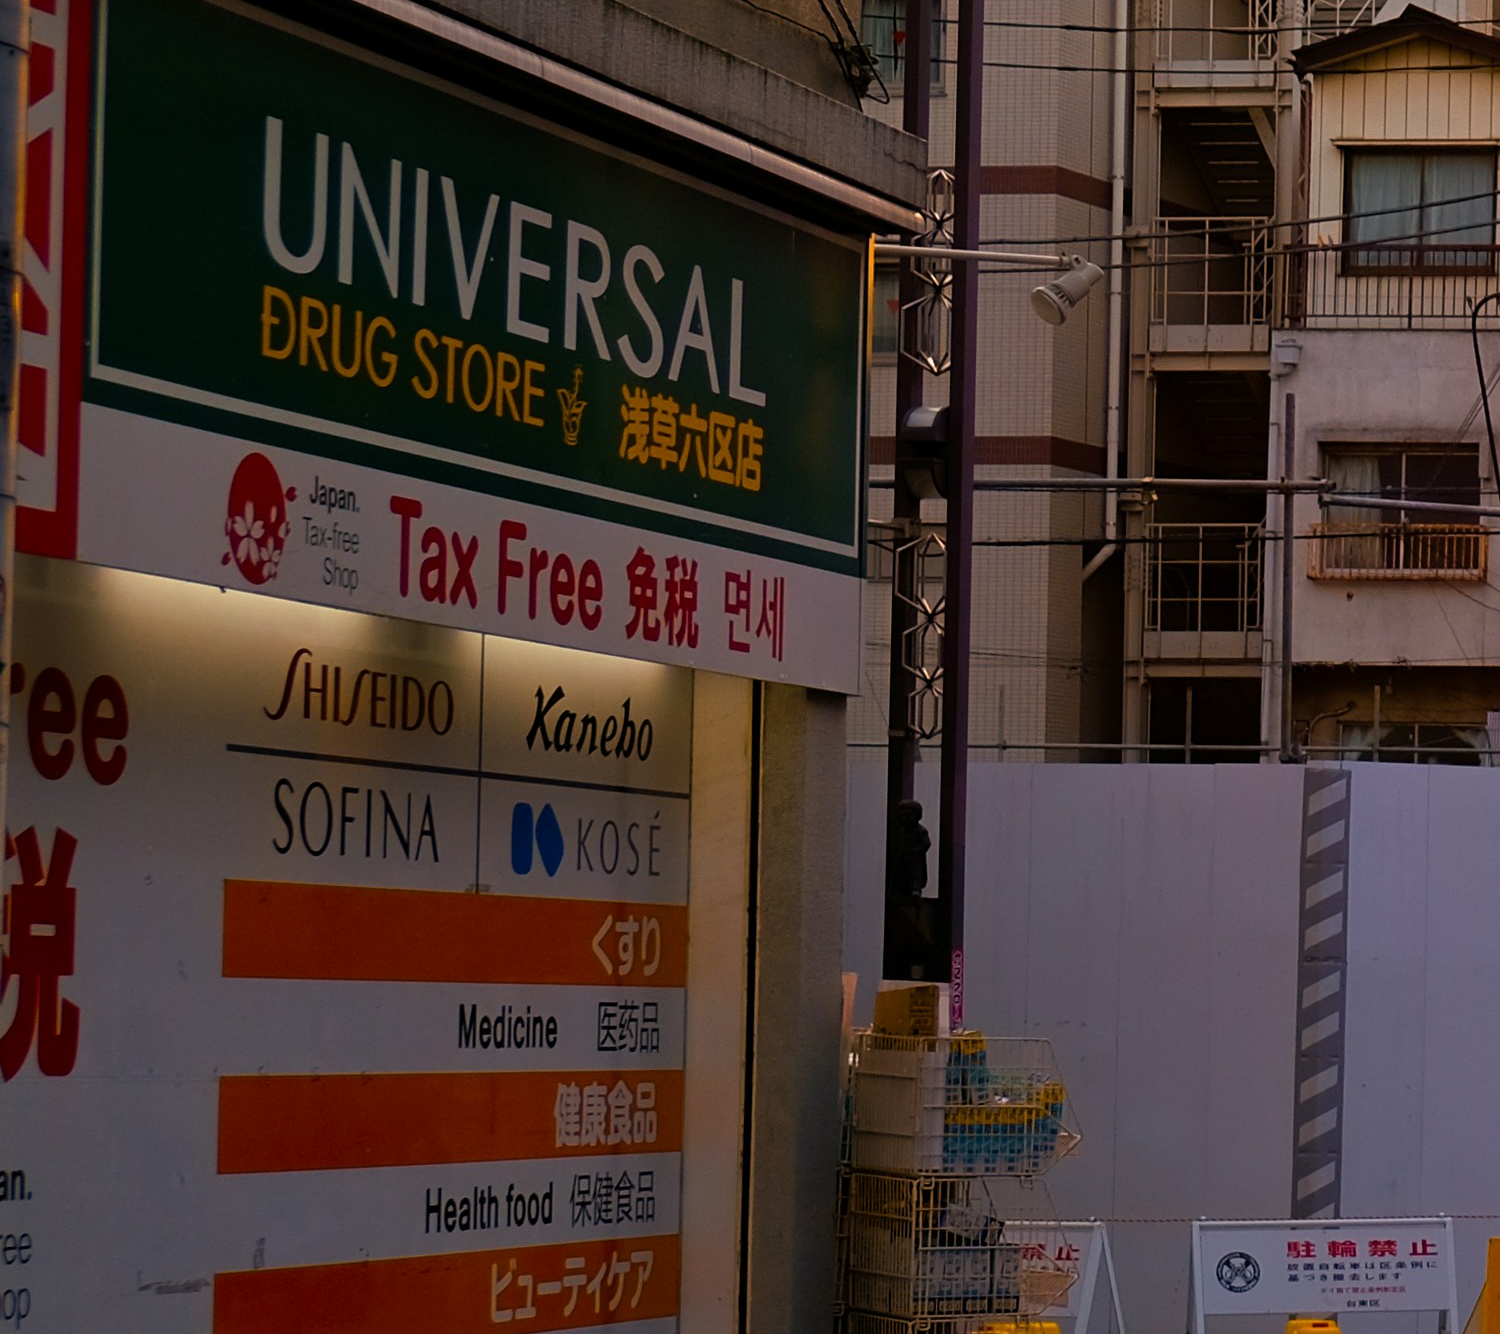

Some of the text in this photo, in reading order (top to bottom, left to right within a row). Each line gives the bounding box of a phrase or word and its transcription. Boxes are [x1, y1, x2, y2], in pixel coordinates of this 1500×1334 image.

[262, 115, 767, 407] UNIVERSAL
[260, 284, 546, 428] DRUG STORE
[619, 384, 764, 493] 浅草六区店
[309, 475, 360, 517] Japan.
[302, 514, 361, 555] Tax-free
[322, 555, 360, 595] Shop
[390, 497, 785, 662] Tax Free 免税 면세
[263, 647, 455, 738] SHISEIDO
[527, 684, 655, 764] Kanebo
[272, 777, 440, 865] SOFINA
[576, 810, 663, 878] KOSÉ
[591, 914, 662, 977] くすり
[458, 1000, 661, 1054] Medicine 医药品
[553, 1081, 659, 1148] 健康食品
[425, 1170, 656, 1235] Health food 保健食品
[1286, 1239, 1438, 1258] 駐輪禁止
